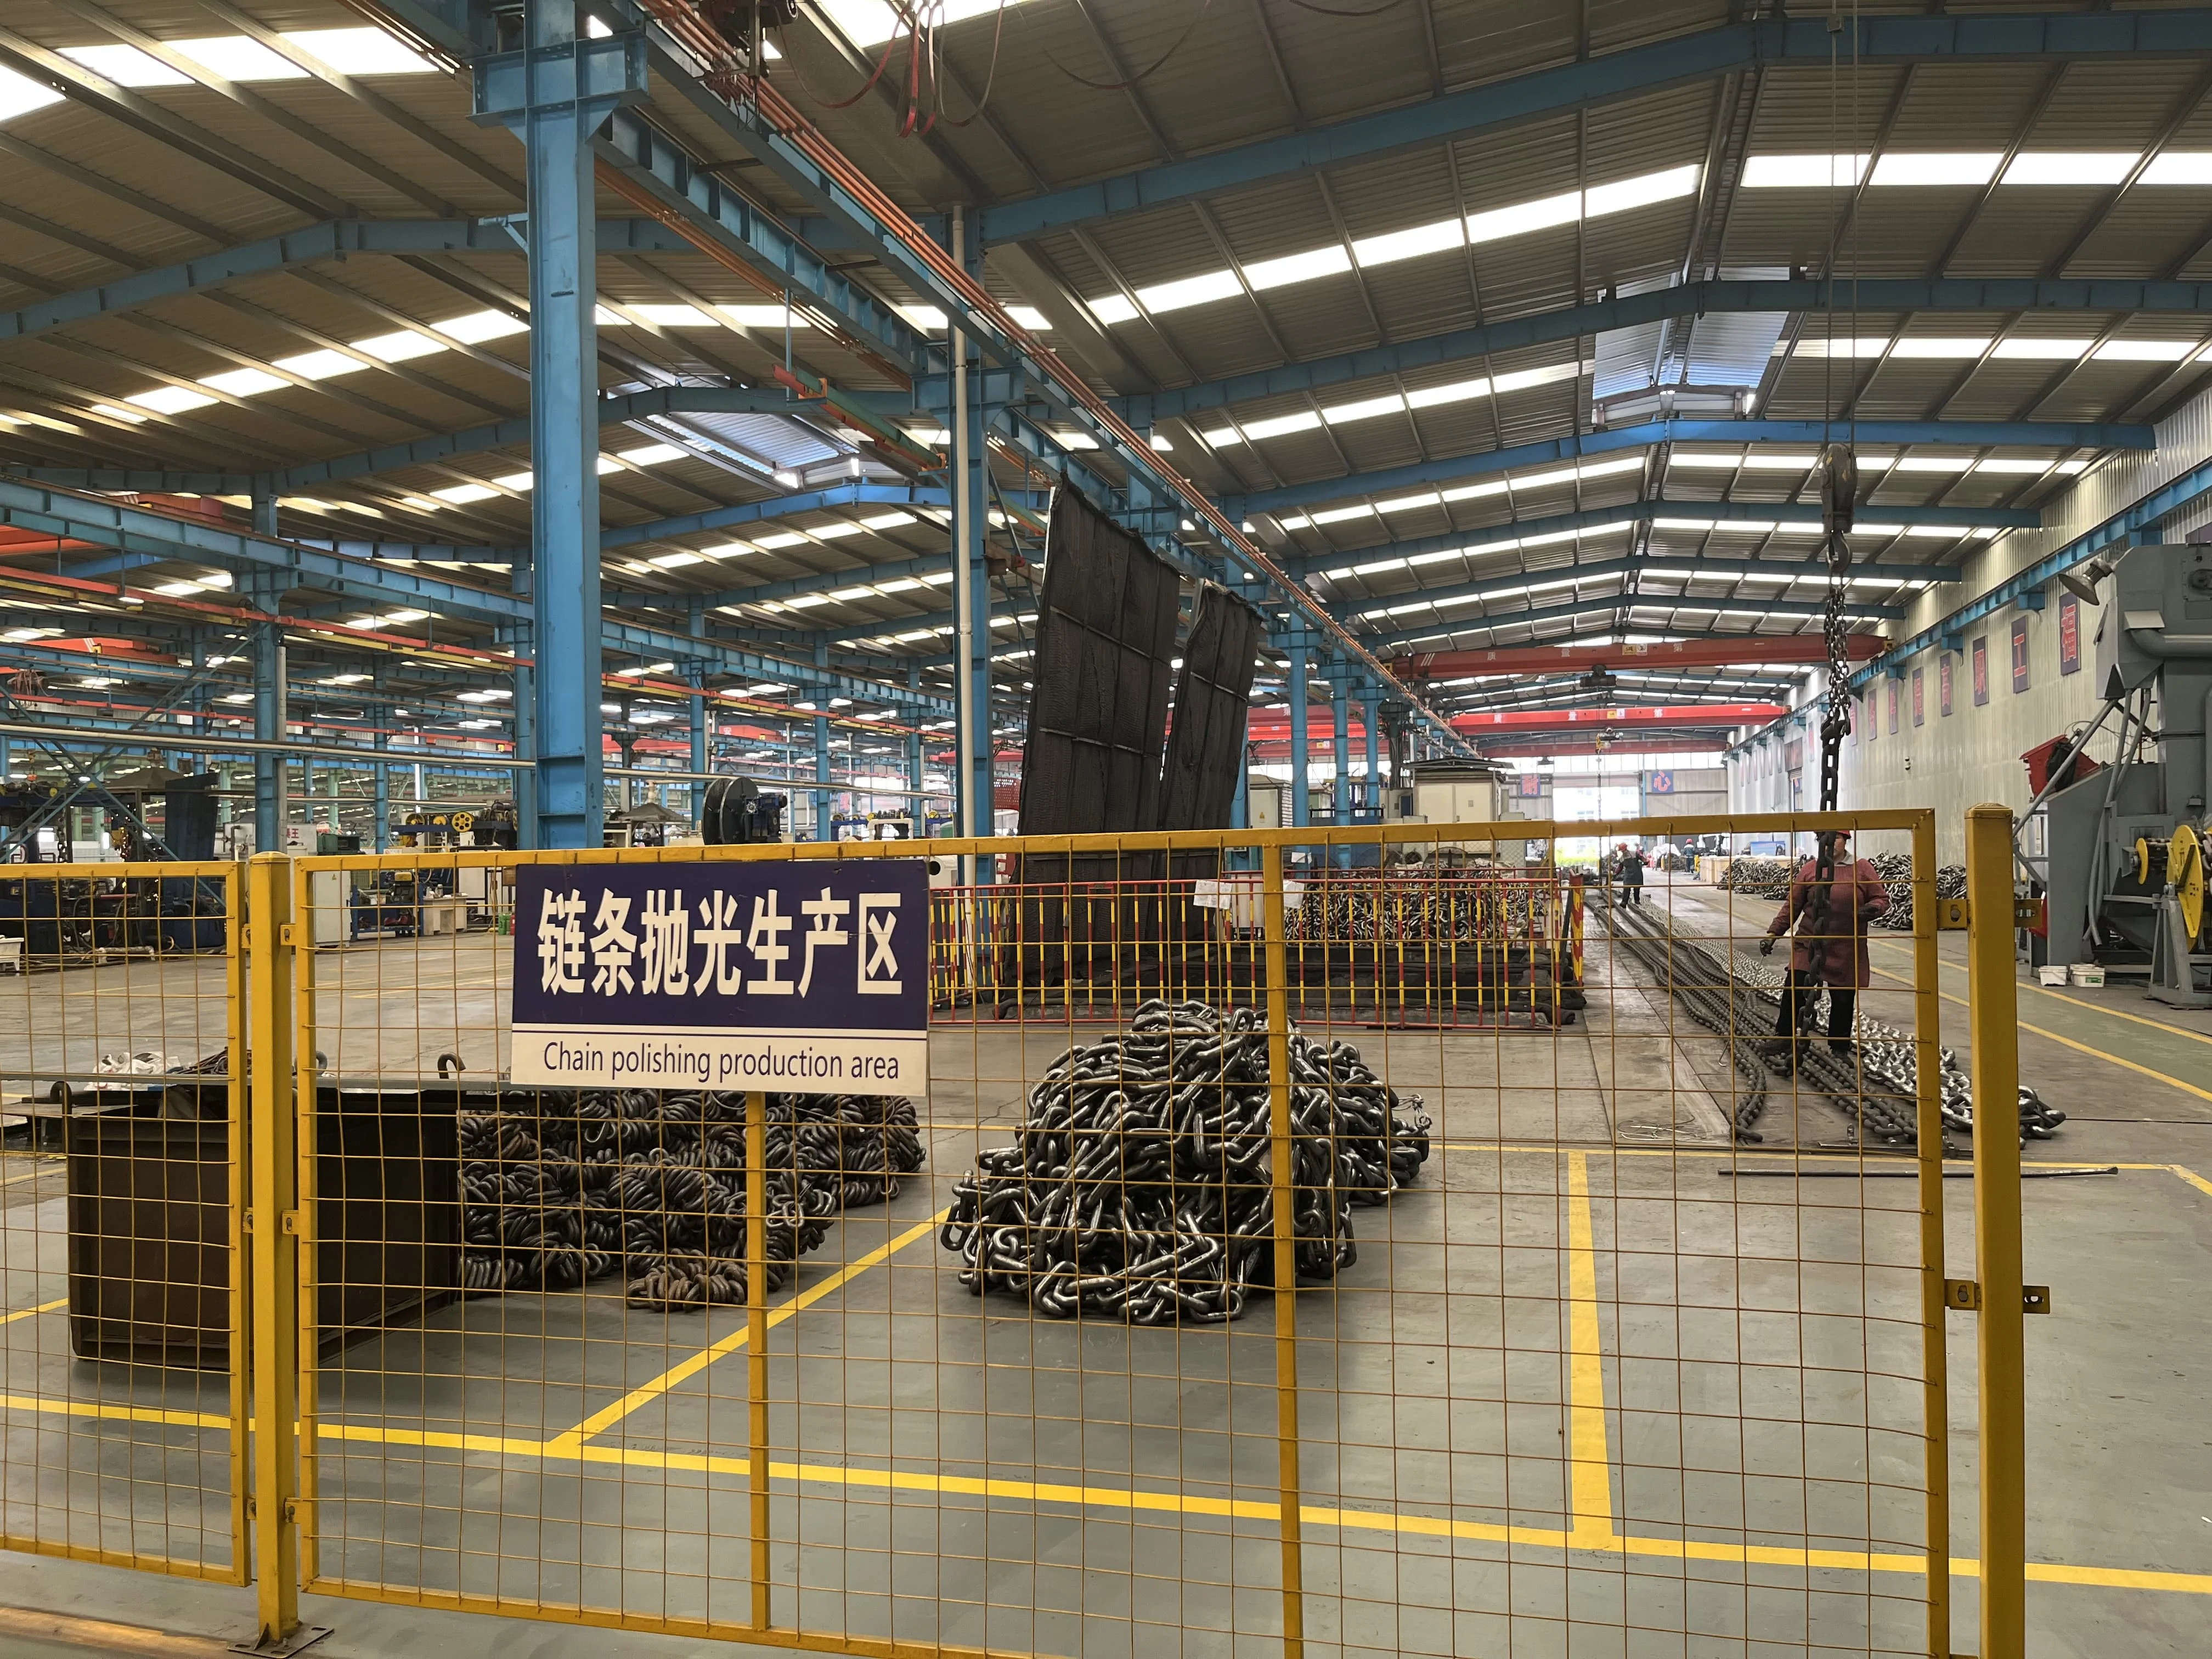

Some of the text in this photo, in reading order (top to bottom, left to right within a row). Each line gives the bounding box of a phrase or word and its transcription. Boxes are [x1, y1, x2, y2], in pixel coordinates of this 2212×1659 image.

[2014, 633, 2027, 678] 工
[2061, 603, 2076, 663] 福
[1654, 771, 1671, 792] 心
[538, 887, 902, 998] 链条抛光生产区
[544, 1041, 899, 1084] Chain polishing production area
